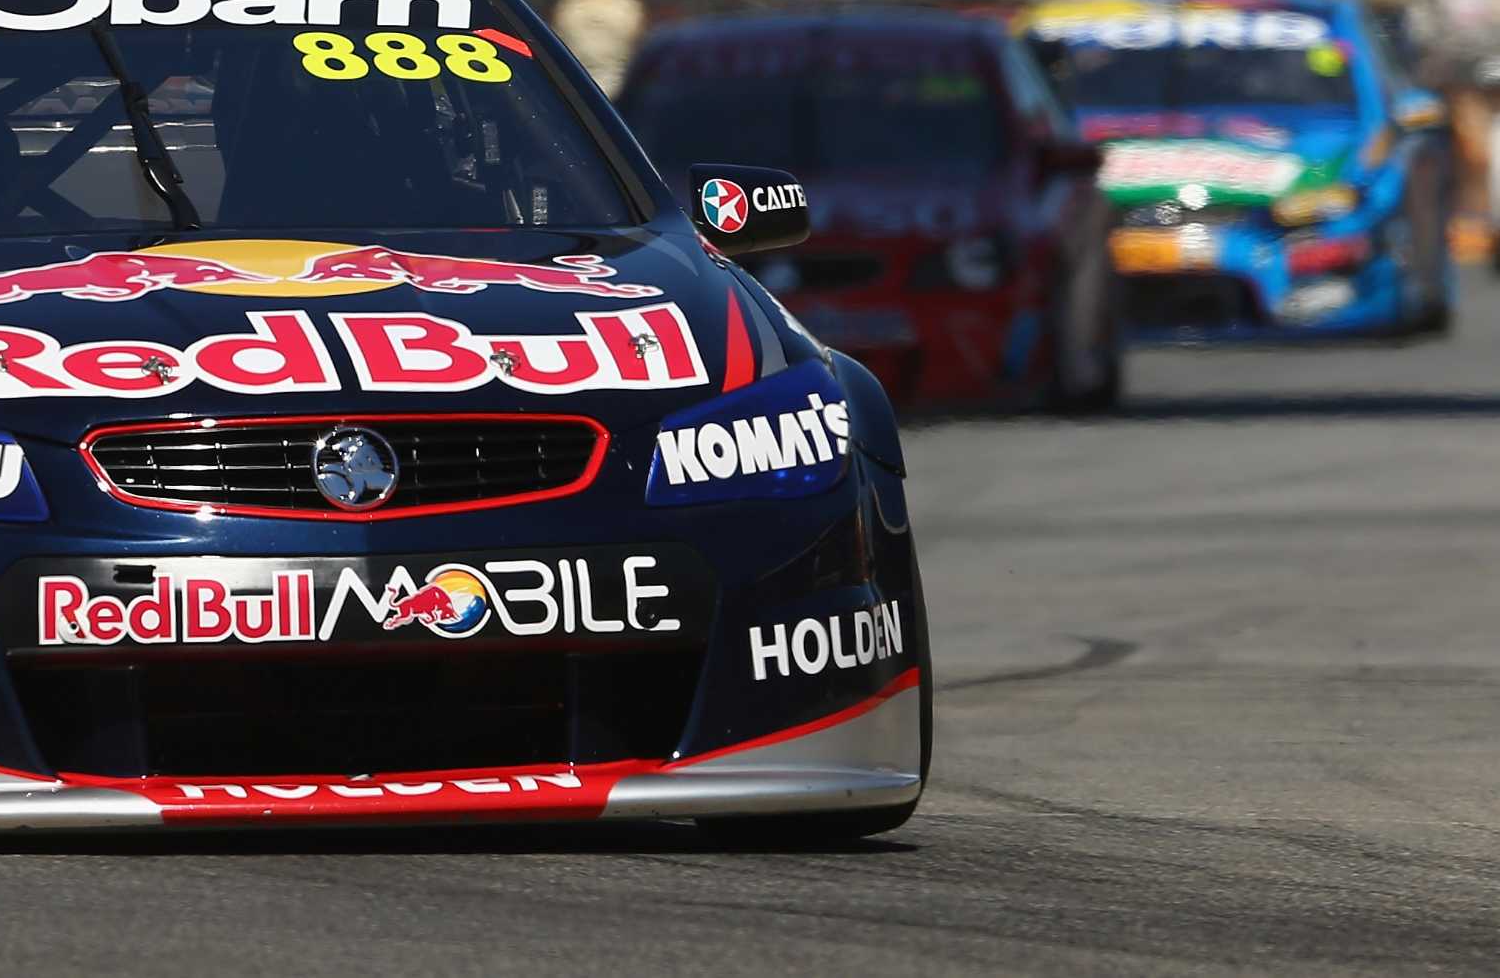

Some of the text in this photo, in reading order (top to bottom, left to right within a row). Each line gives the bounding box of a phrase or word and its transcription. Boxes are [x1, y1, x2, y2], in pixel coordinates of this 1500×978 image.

[293, 31, 513, 83] 888
[332, 302, 710, 396] Bull
[750, 600, 903, 681] HOLDEN
